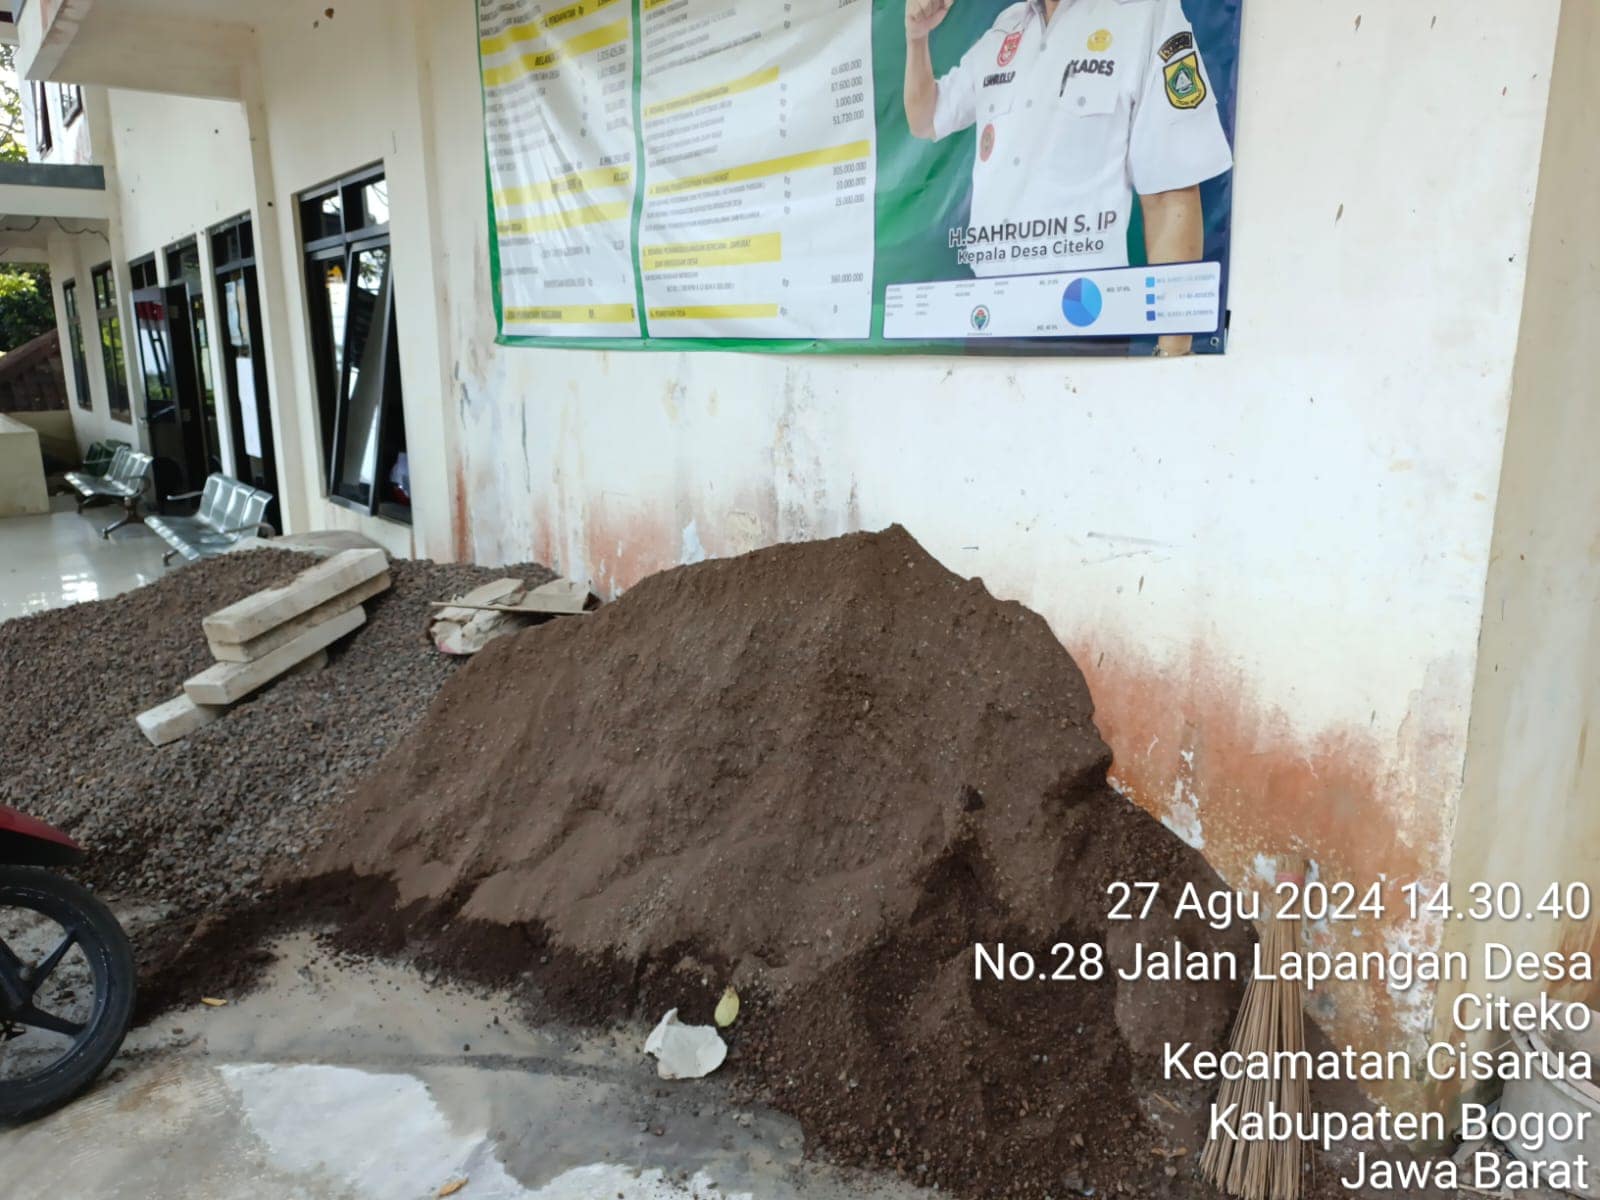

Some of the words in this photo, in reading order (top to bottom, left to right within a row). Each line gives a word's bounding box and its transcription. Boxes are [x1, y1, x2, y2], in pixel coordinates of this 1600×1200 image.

[1069, 59, 1115, 77] KADES
[949, 216, 1068, 248] H.SAHRUDIN
[1073, 213, 1091, 233] S.
[1097, 210, 1118, 231] IP
[958, 246, 1006, 265] Kepala
[1011, 244, 1047, 259] Desa
[1053, 238, 1104, 255] Citeko
